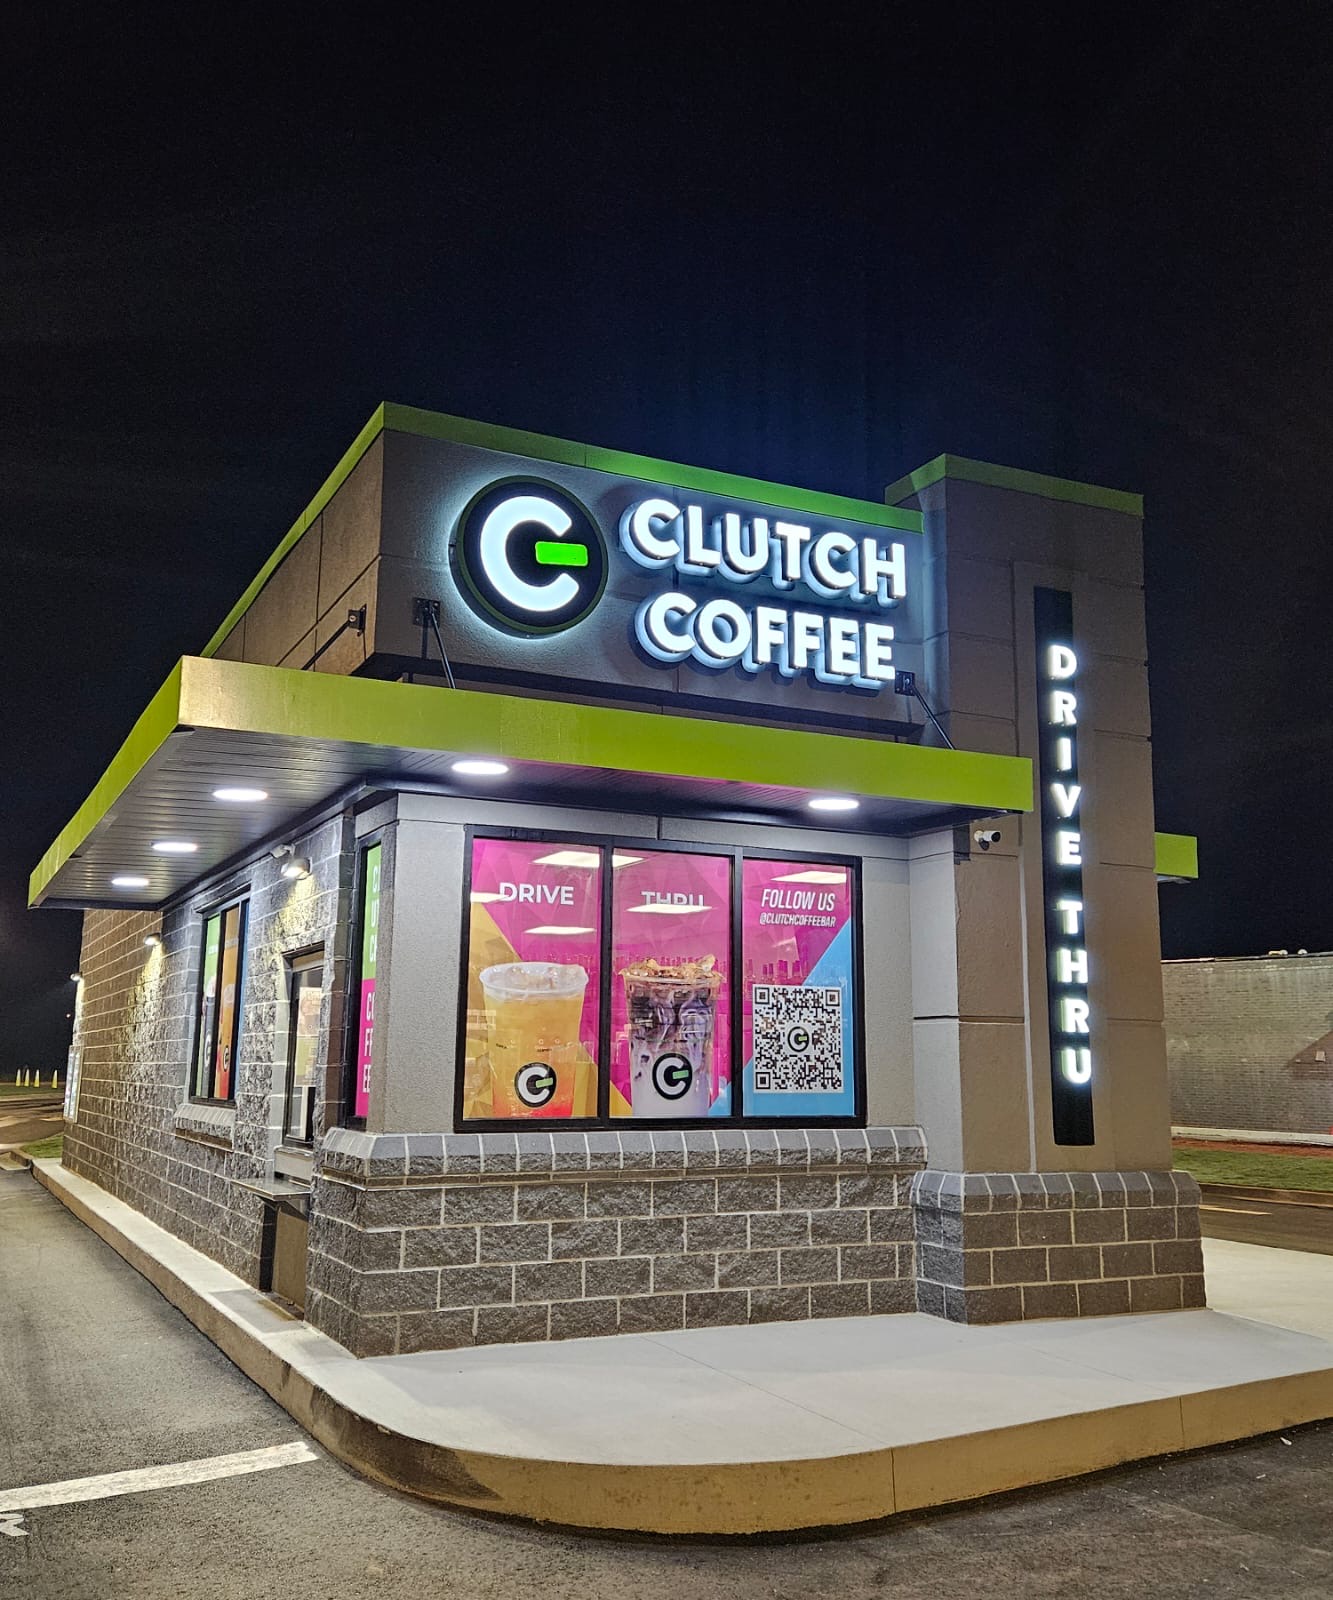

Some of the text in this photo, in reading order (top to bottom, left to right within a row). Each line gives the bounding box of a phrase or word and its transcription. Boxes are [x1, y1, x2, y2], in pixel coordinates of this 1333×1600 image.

[628, 498, 907, 601] CLUTCH
[644, 592, 896, 682] COFFEE
[1048, 644, 1092, 1085] DRIVE THRU
[499, 882, 575, 905] DRIVE
[760, 912, 837, 928] @CLUTCHCOFFEEBAR
[761, 888, 836, 911] FOLLOW US
